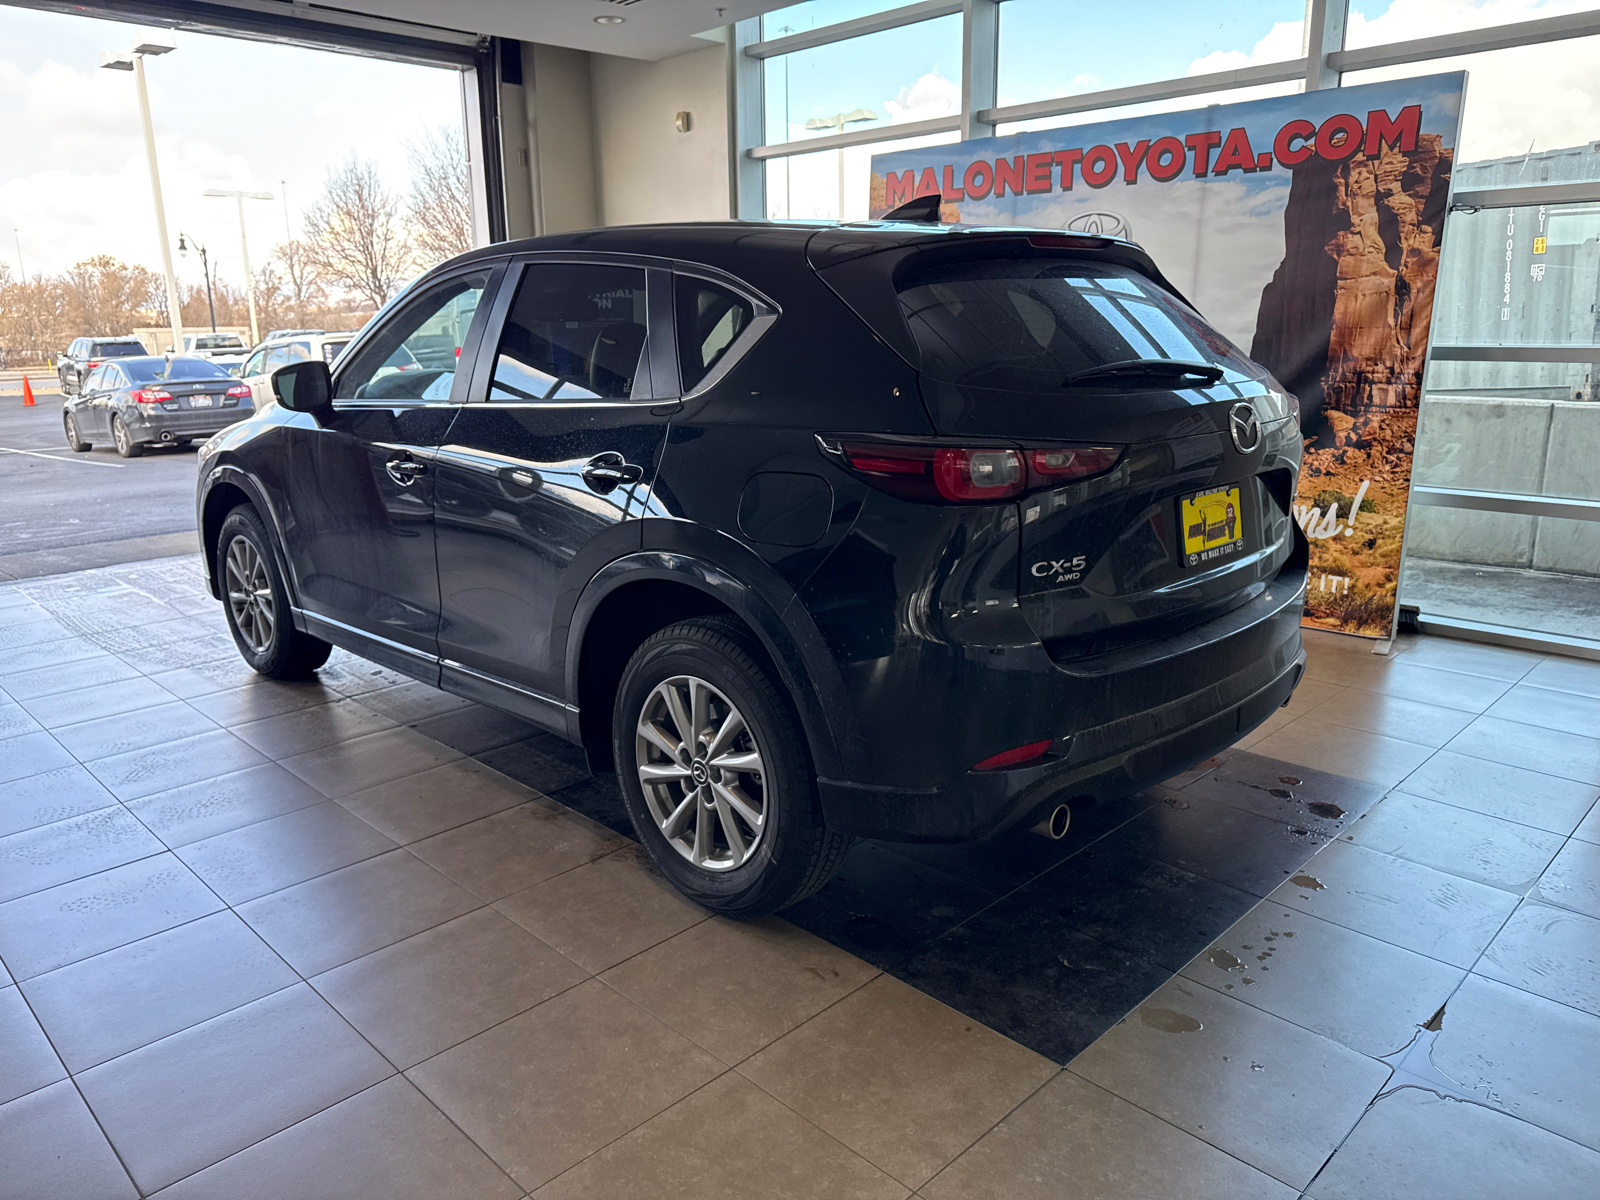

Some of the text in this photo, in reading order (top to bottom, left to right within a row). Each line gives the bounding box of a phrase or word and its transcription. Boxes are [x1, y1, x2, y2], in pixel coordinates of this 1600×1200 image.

[885, 104, 1421, 208] MALONETOYOTA.COM
[1503, 239, 1513, 304] 081884
[1227, 507, 1234, 517] 32
[1201, 552, 1208, 561] WE
[1209, 548, 1220, 558] MAKE
[1225, 543, 1234, 554] EASY
[1031, 555, 1086, 577] CX-5
[1056, 572, 1080, 583] AWD
[1320, 574, 1350, 595] IT!
